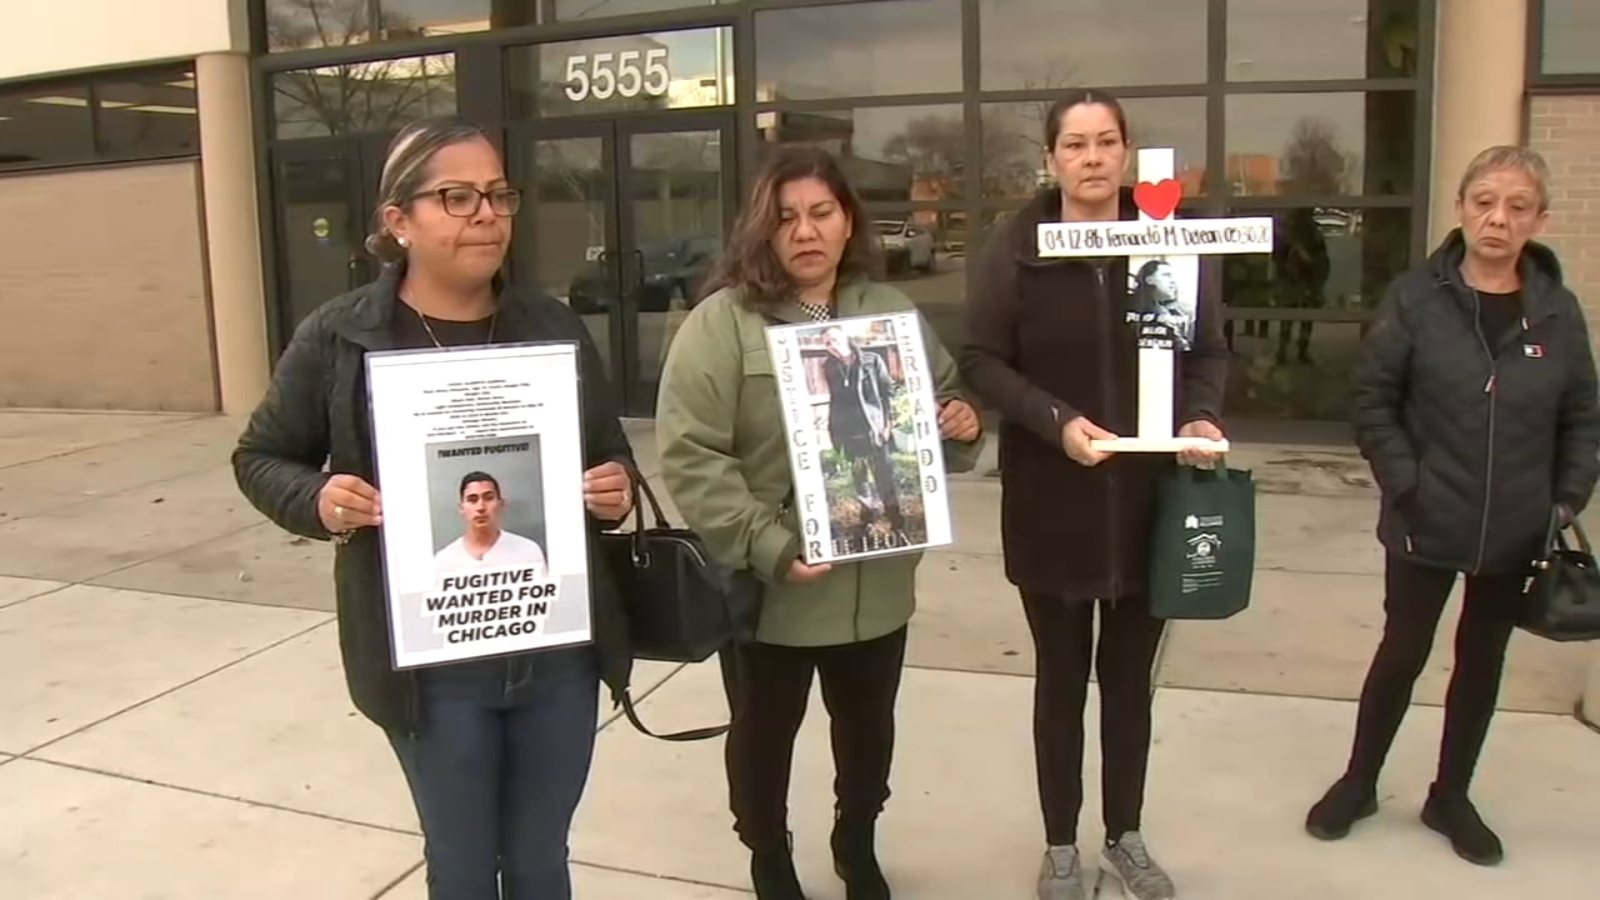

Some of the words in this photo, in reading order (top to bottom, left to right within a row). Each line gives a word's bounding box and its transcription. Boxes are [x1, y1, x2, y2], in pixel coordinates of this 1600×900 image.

[565, 48, 669, 101] 5555
[899, 316, 938, 493] FERNANDO
[804, 494, 824, 559] FOR
[442, 568, 534, 592] FUGITIVE
[426, 589, 514, 611] WANTED
[518, 583, 556, 601] FOR
[438, 605, 522, 628] MURDER
[526, 602, 547, 617] IN
[447, 620, 536, 644] CHICAGO
